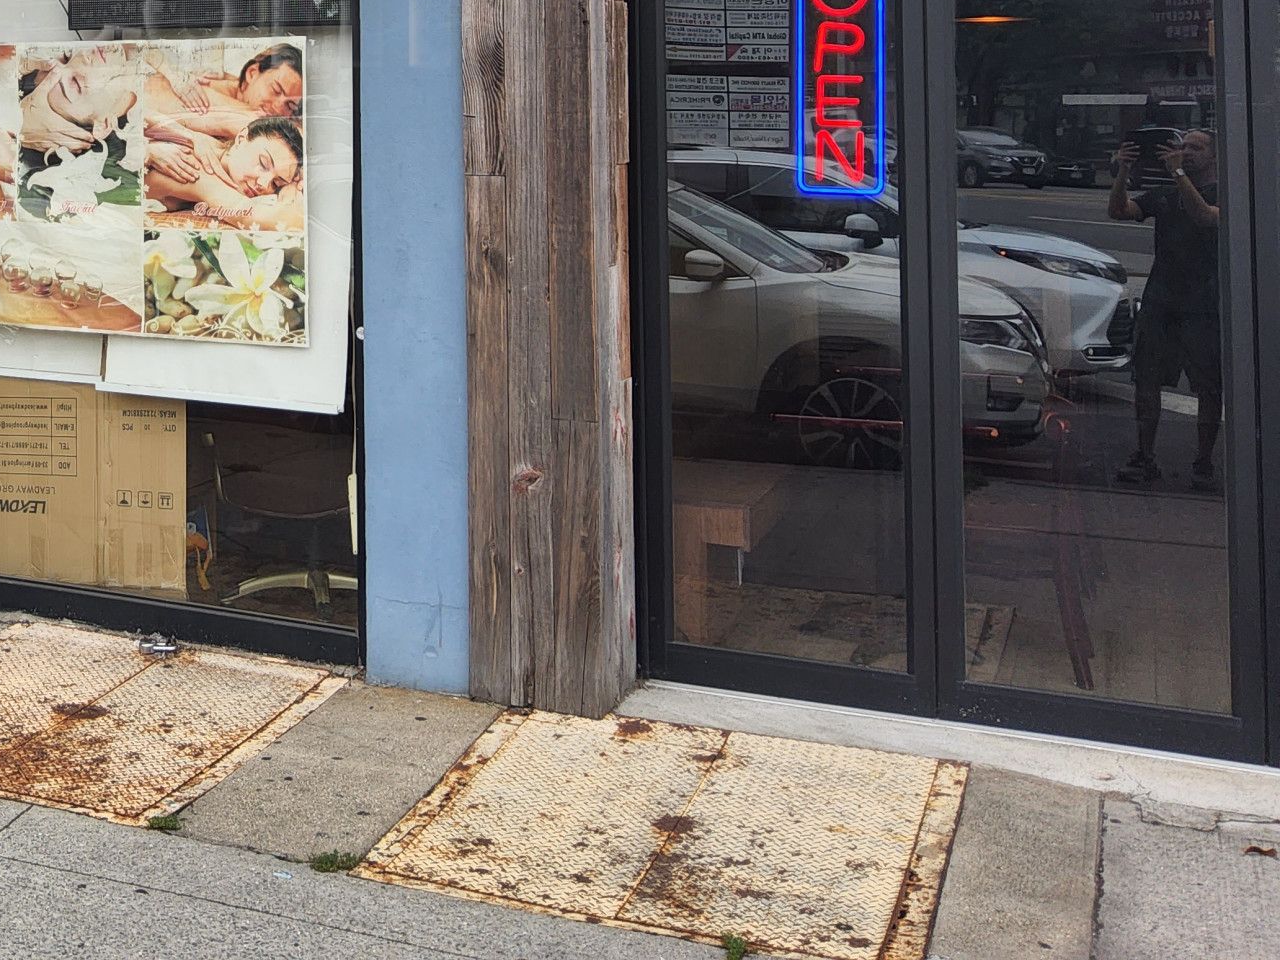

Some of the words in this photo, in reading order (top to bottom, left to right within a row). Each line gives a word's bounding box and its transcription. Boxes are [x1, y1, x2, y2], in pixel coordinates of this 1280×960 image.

[60, 200, 98, 215] Facial
[192, 201, 257, 220] Bodywork
[54, 423, 75, 432] E-MAIL
[121, 423, 134, 431] PCS
[58, 442, 70, 450] TEL
[57, 461, 71, 470] ADD
[15, 484, 56, 495] LEADWAY
